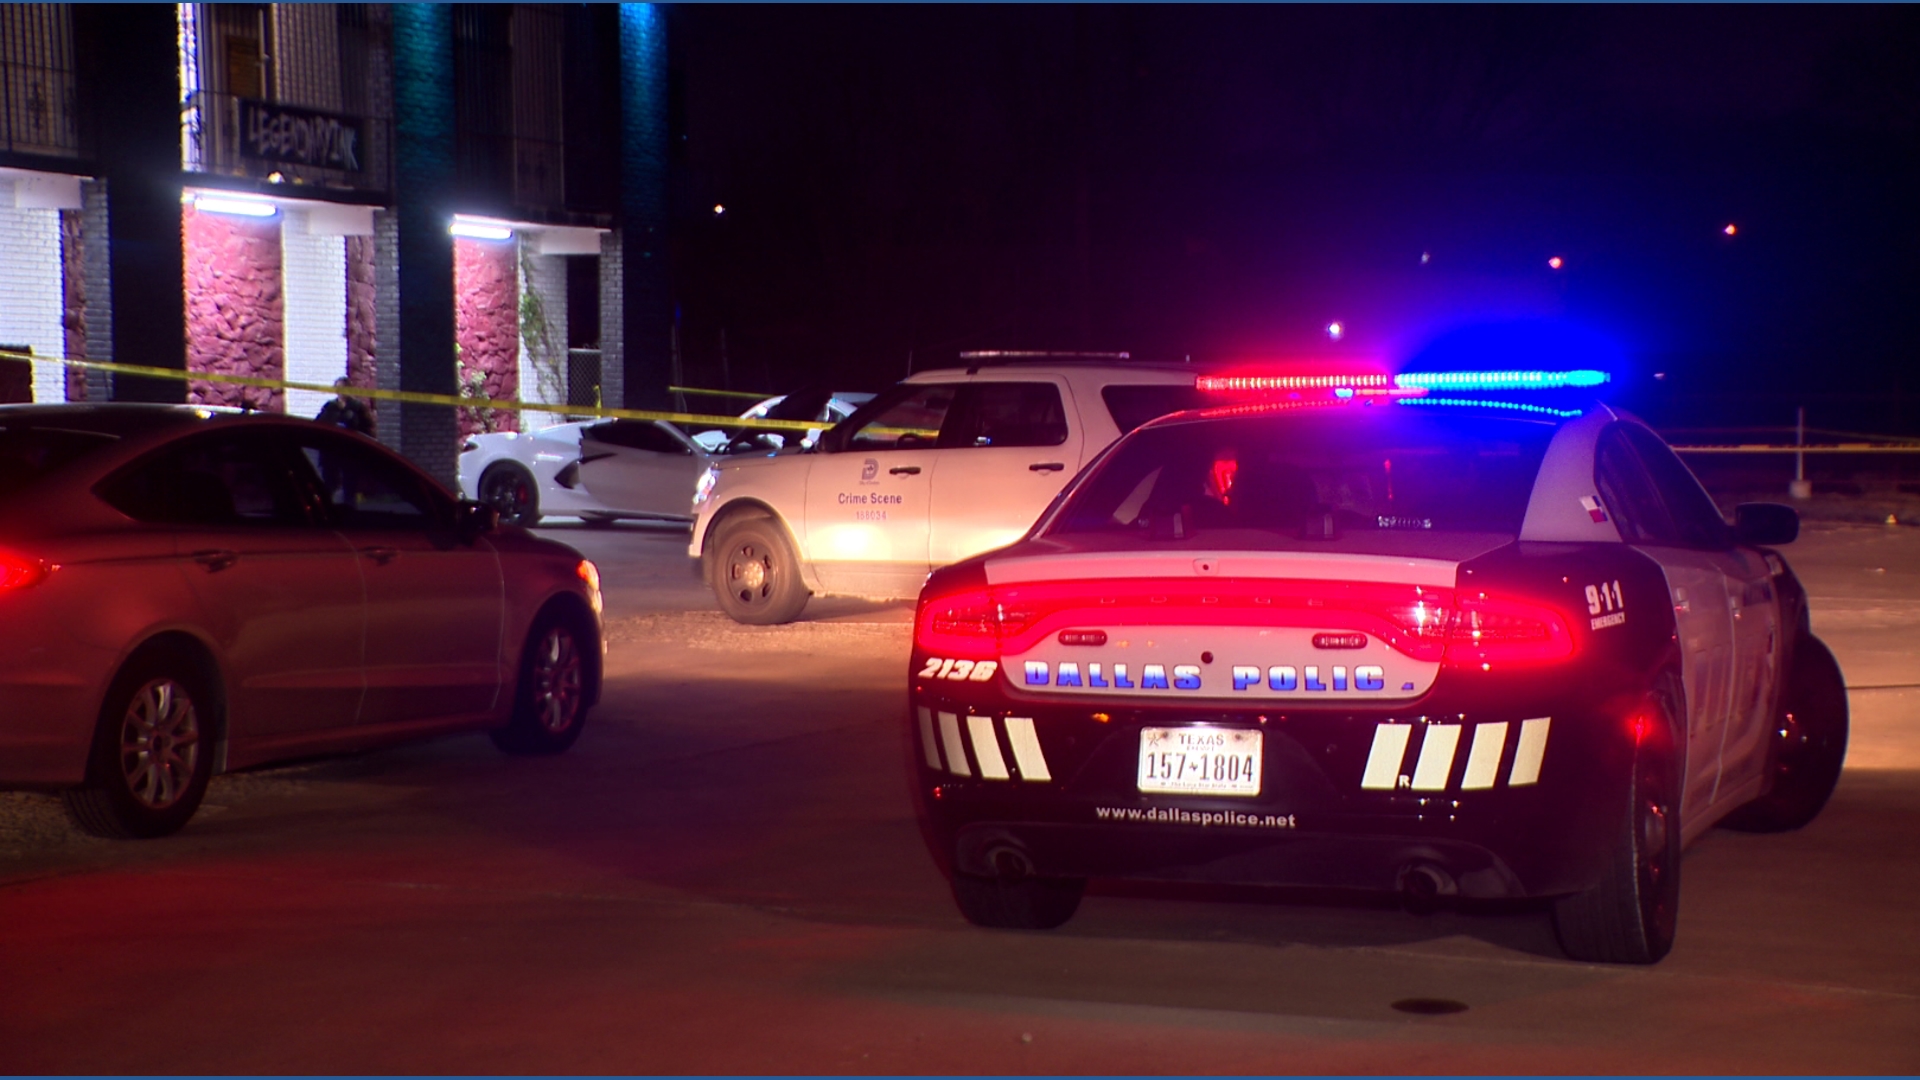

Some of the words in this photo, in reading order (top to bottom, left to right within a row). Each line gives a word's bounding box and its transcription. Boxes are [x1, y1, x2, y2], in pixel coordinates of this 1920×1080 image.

[838, 492, 868, 505] Crime
[870, 492, 902, 505] Scene
[918, 657, 998, 682] 2136
[1024, 661, 1202, 690] DALLAS
[1232, 665, 1415, 691] POLIC
[1178, 733, 1225, 746] TEXAS
[1096, 806, 1296, 828] www.dallaspolice.net
